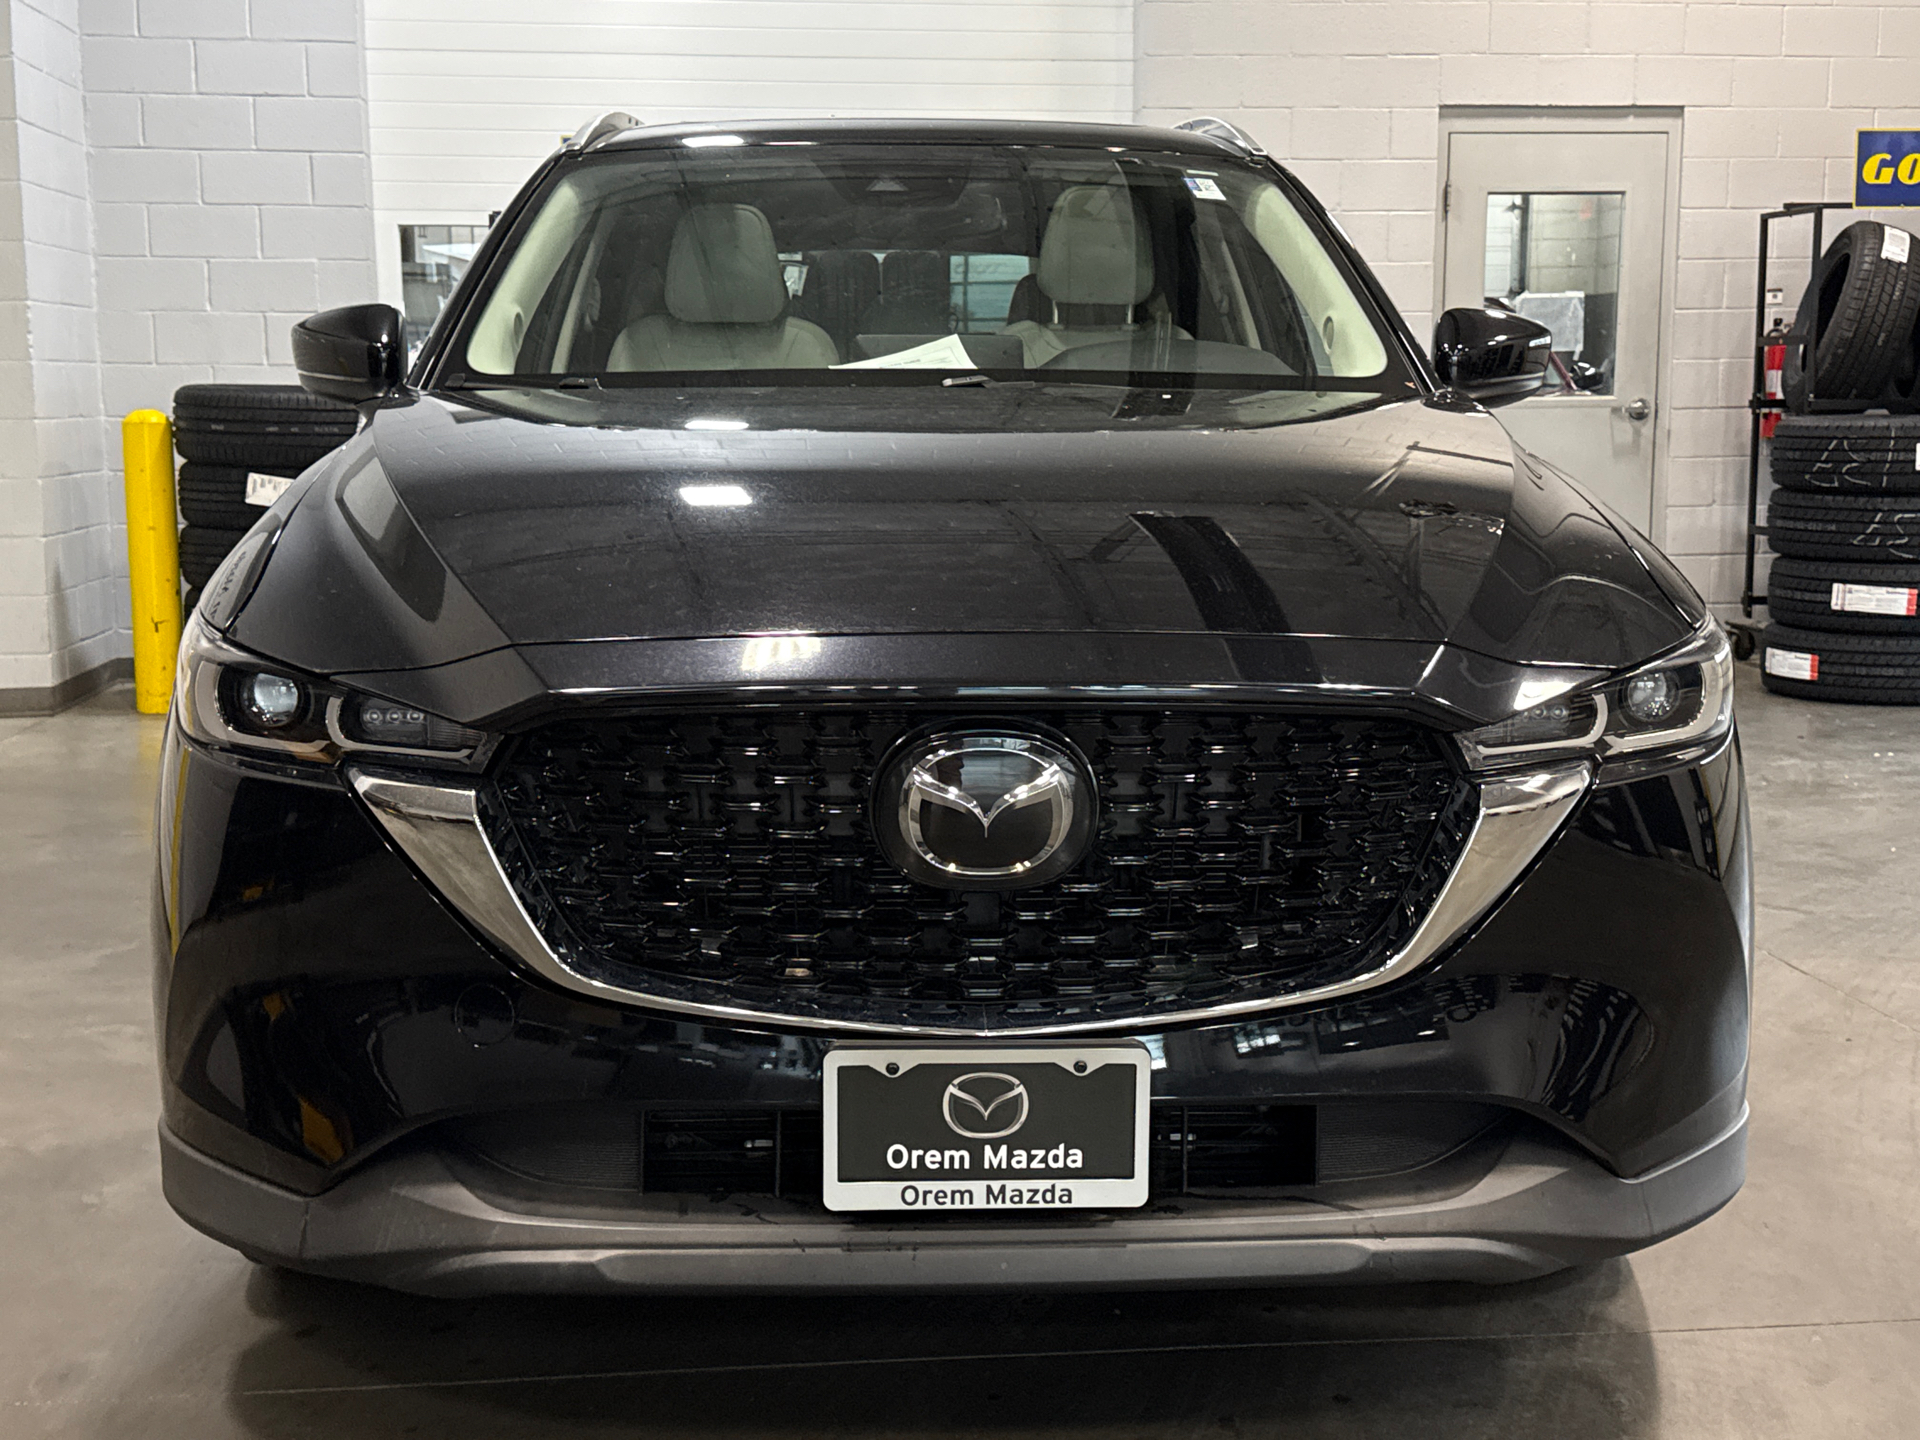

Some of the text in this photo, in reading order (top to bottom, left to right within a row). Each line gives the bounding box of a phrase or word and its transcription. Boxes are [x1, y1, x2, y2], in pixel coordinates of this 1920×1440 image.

[886, 1142, 1083, 1170] Orem Mazda
[900, 1183, 1073, 1207] Orem Mazda
